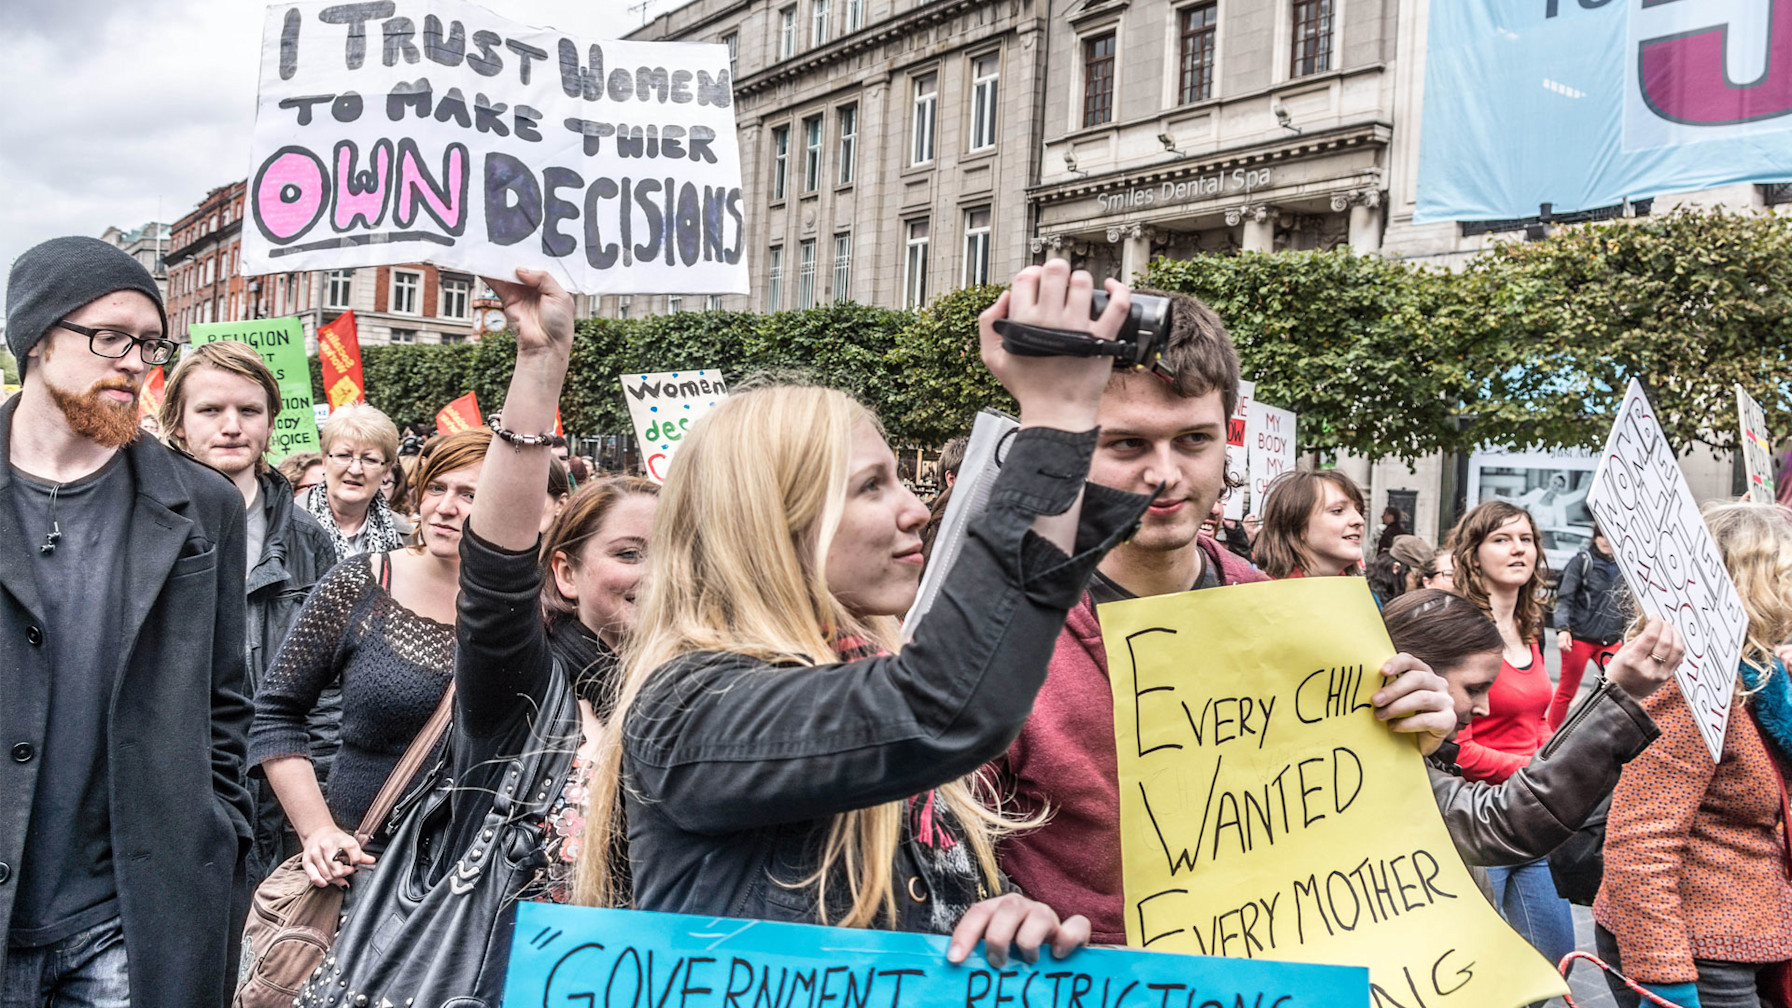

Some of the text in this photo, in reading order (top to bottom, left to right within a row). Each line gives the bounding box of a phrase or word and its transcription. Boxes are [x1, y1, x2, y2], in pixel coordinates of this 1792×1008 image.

[279, 0, 731, 109] I TRUST WOMEN
[278, 77, 718, 164] TO MAKE THIER
[252, 137, 744, 270] OWN DECISIONS
[1096, 167, 1272, 213] Smiles Dental Spa
[271, 433, 312, 451] HOICE
[277, 417, 300, 430] ODY
[1258, 432, 1288, 455] BODY
[1265, 413, 1281, 432] MY
[1125, 627, 1374, 758] EVERY CHIL
[1138, 746, 1364, 876] WANTED
[1293, 849, 1459, 945] MOTHER
